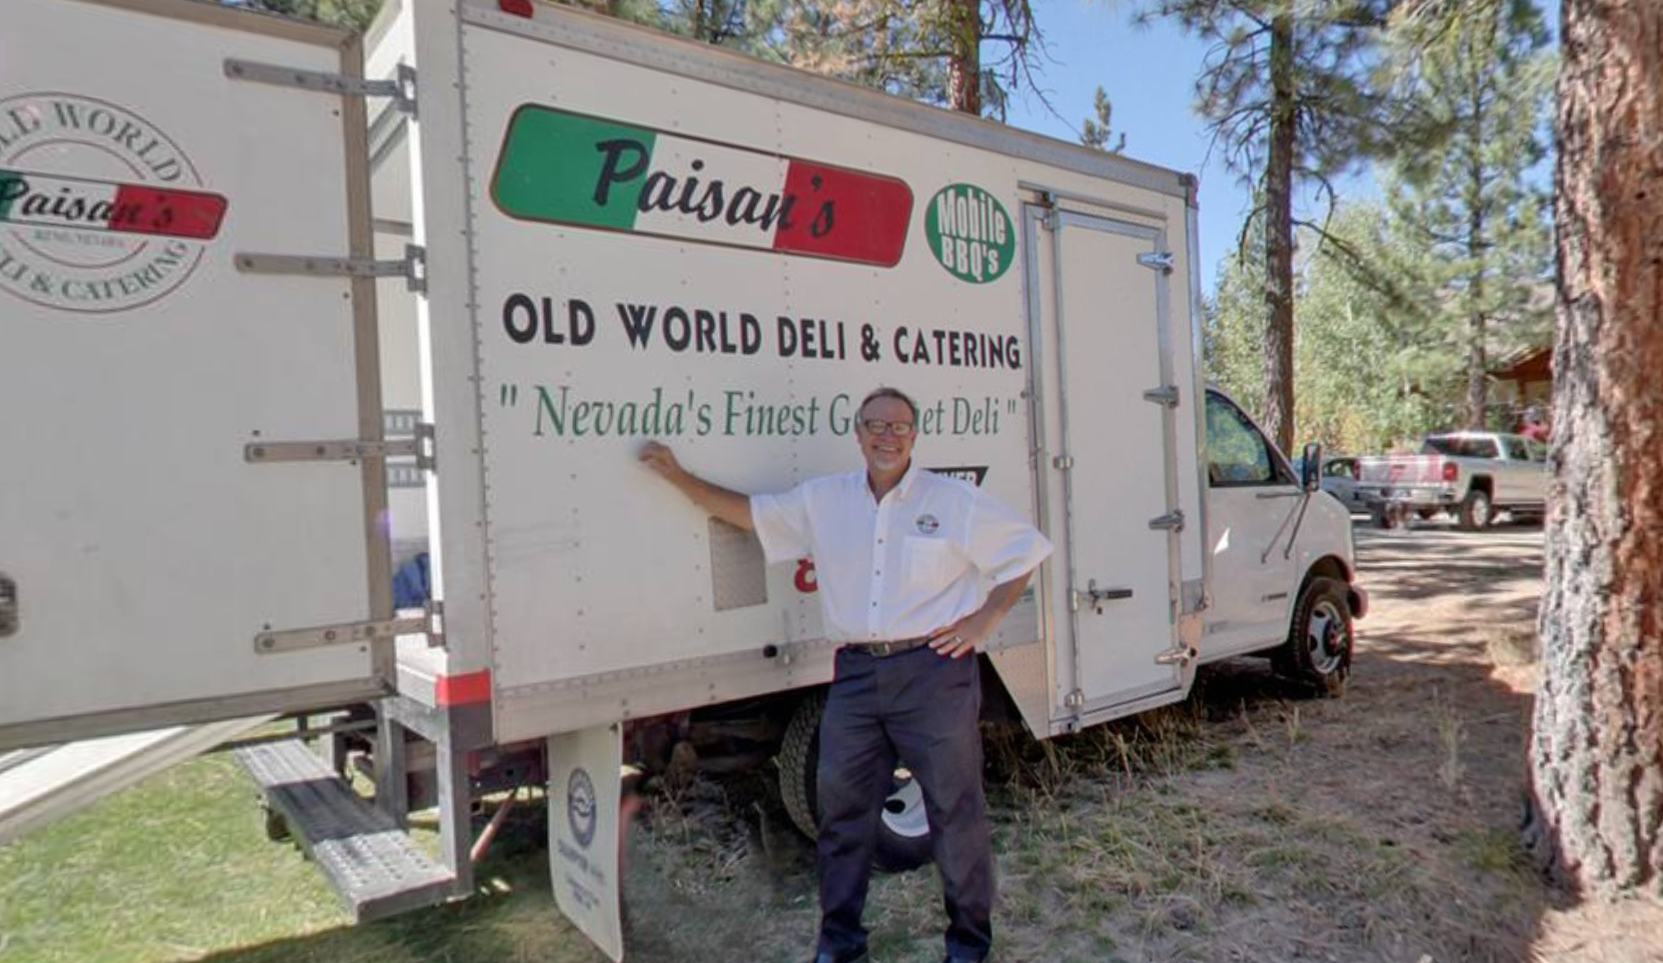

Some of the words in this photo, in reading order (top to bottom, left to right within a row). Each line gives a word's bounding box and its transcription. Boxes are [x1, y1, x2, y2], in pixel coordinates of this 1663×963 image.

[0, 106, 40, 147] LD
[54, 102, 182, 182] WORLD
[591, 138, 835, 238] Paisan's
[936, 187, 1006, 246] Mobile
[31, 274, 51, 294] &
[61, 240, 188, 301] CATERING
[940, 234, 1000, 282] BBQ's
[503, 293, 596, 346] OLD
[616, 303, 762, 355] WORLD
[777, 316, 846, 360] DELI
[860, 323, 881, 362] &
[893, 326, 1023, 370] CATERING
[532, 384, 713, 437] Nevada's
[722, 389, 820, 437] Finest
[952, 396, 1001, 435] Deli
